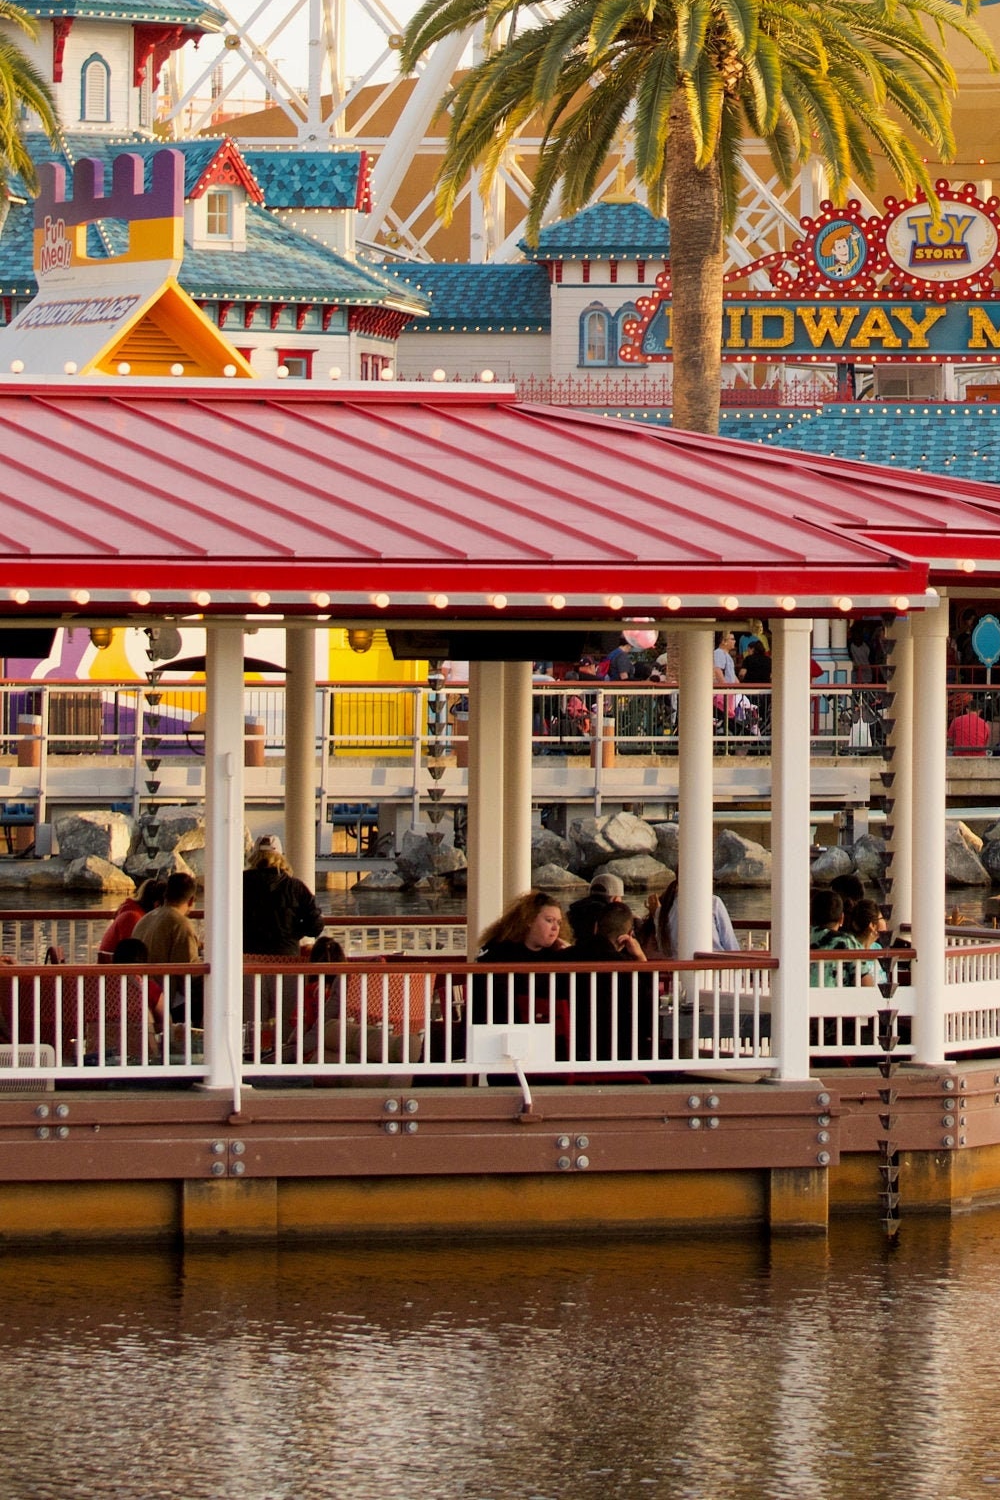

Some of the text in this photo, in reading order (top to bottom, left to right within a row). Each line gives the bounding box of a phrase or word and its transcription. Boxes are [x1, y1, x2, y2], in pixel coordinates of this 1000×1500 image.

[44, 216, 65, 245] Fun
[907, 213, 977, 246] TOY
[41, 240, 72, 276] Meal!
[915, 248, 965, 259] STORY
[16, 295, 140, 330] POULTRY PALACE
[665, 306, 946, 348] IDWAY
